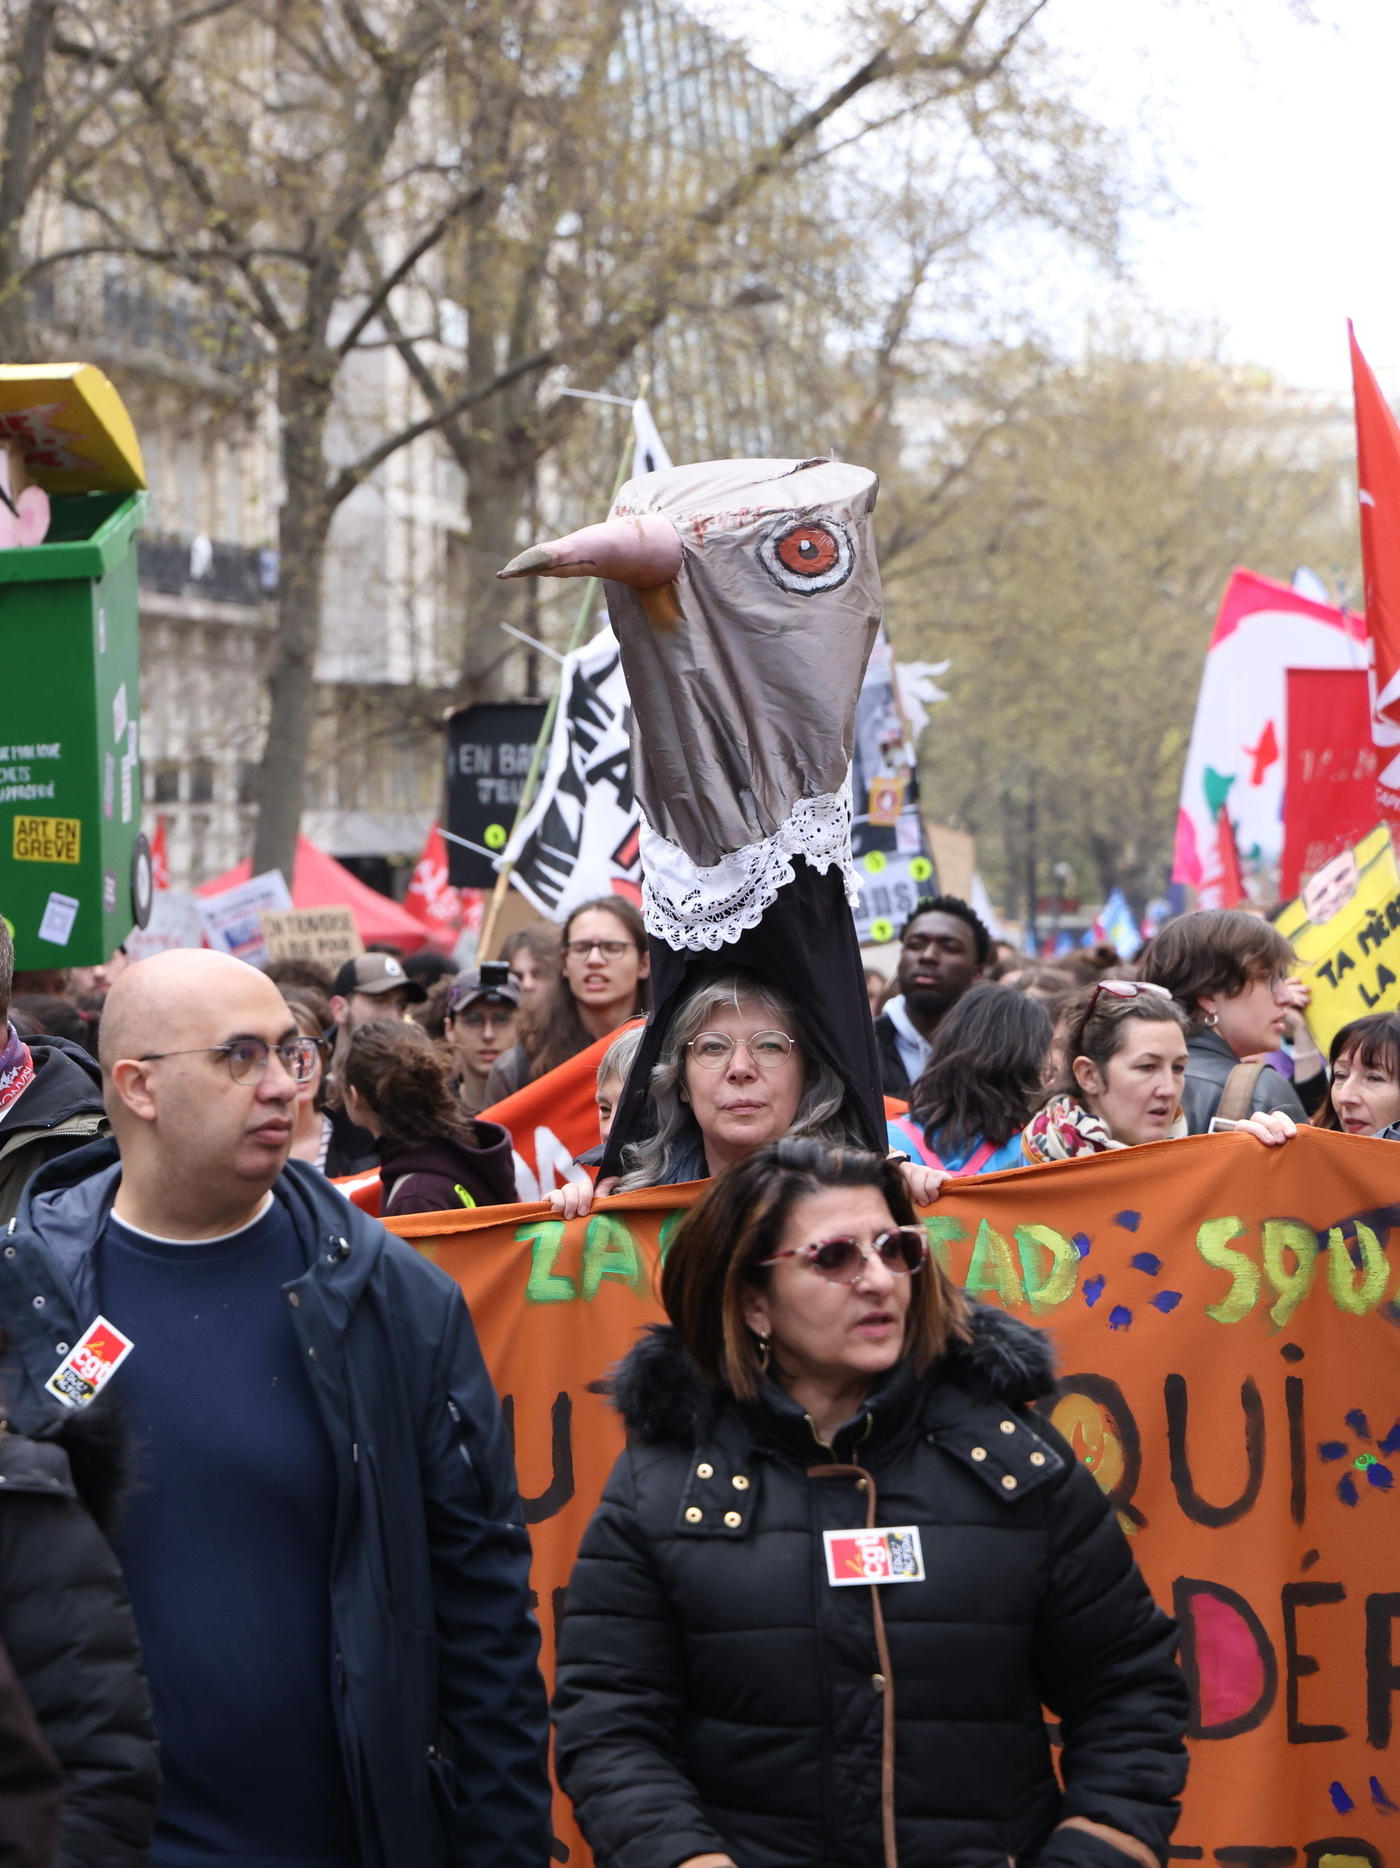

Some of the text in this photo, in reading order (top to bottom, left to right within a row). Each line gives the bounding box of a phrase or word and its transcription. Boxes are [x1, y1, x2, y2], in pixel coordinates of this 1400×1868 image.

[55, 821, 77, 840] EN
[1316, 950, 1356, 989] TA
[1358, 962, 1397, 1009] LA
[73, 1346, 112, 1388] cgt
[854, 1536, 888, 1579] cgt
